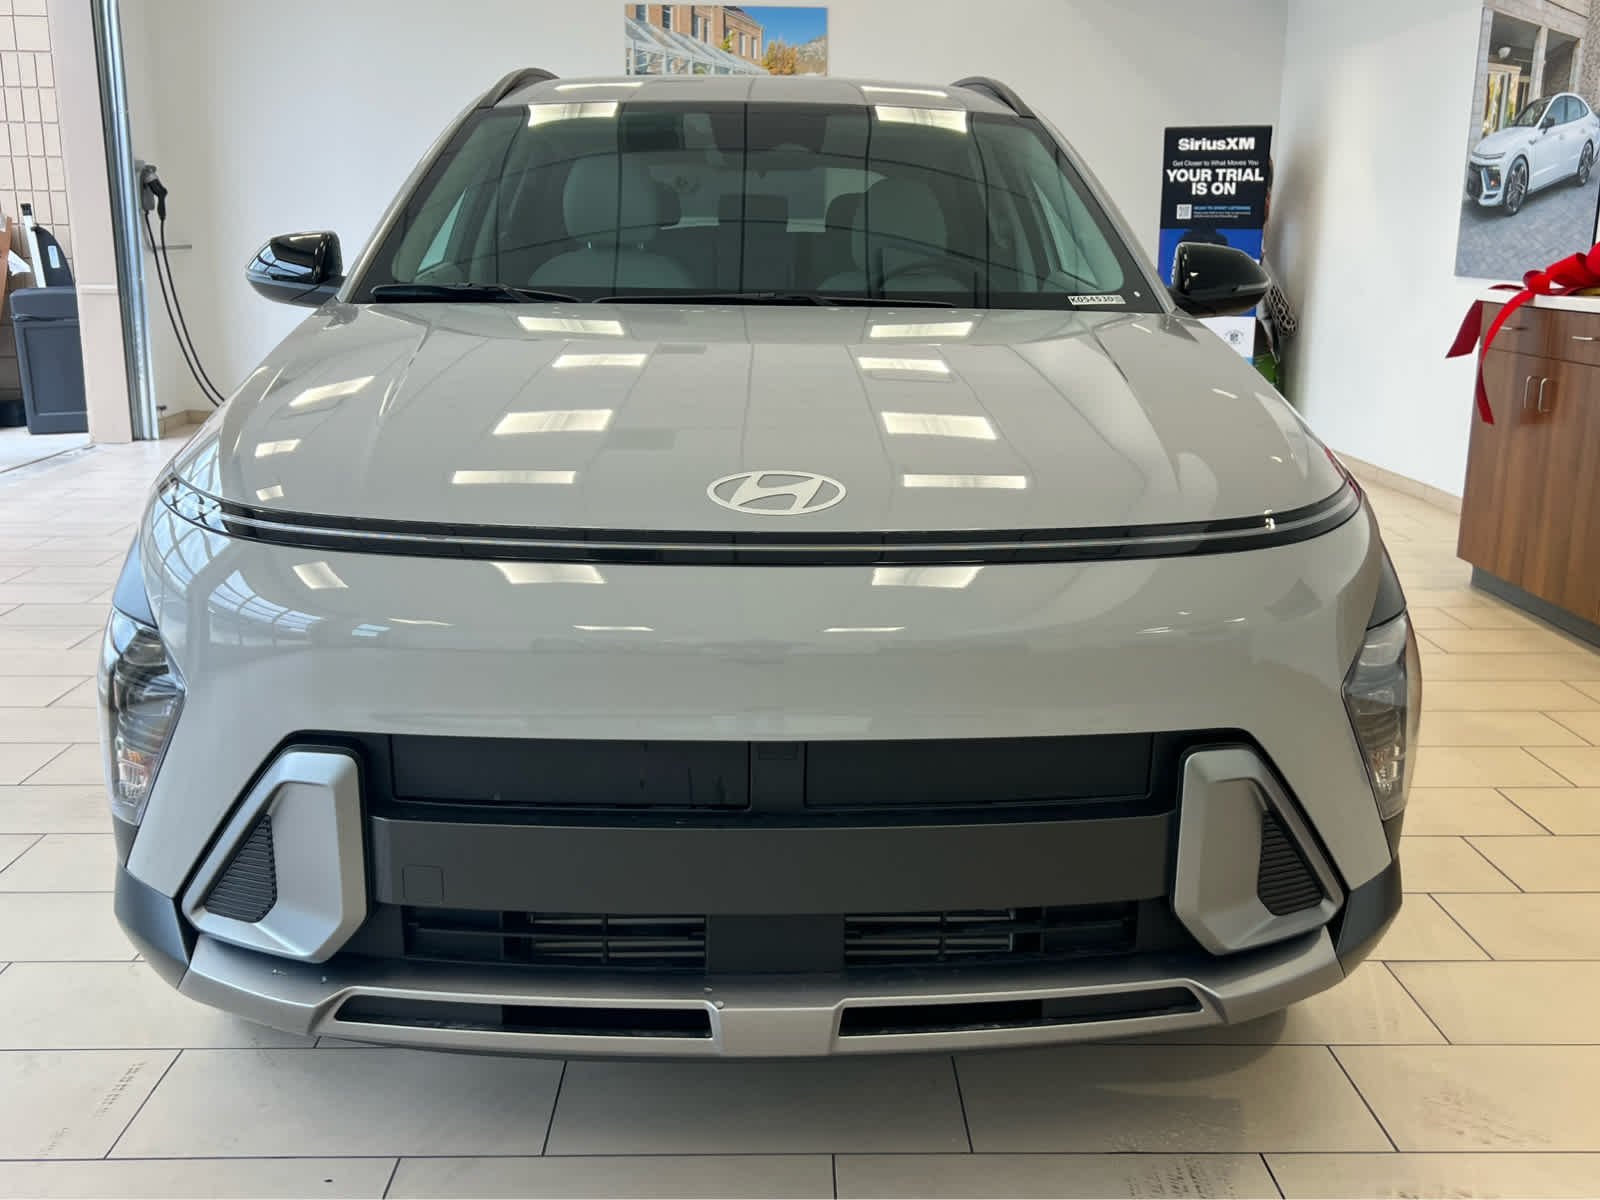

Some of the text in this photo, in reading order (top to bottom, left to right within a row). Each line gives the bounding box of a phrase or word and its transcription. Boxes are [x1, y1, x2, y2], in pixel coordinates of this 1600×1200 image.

[1178, 137, 1255, 151] SiriusXM
[1166, 168, 1264, 182] YOUR TRIAL
[1191, 182, 1236, 195] IS ON
